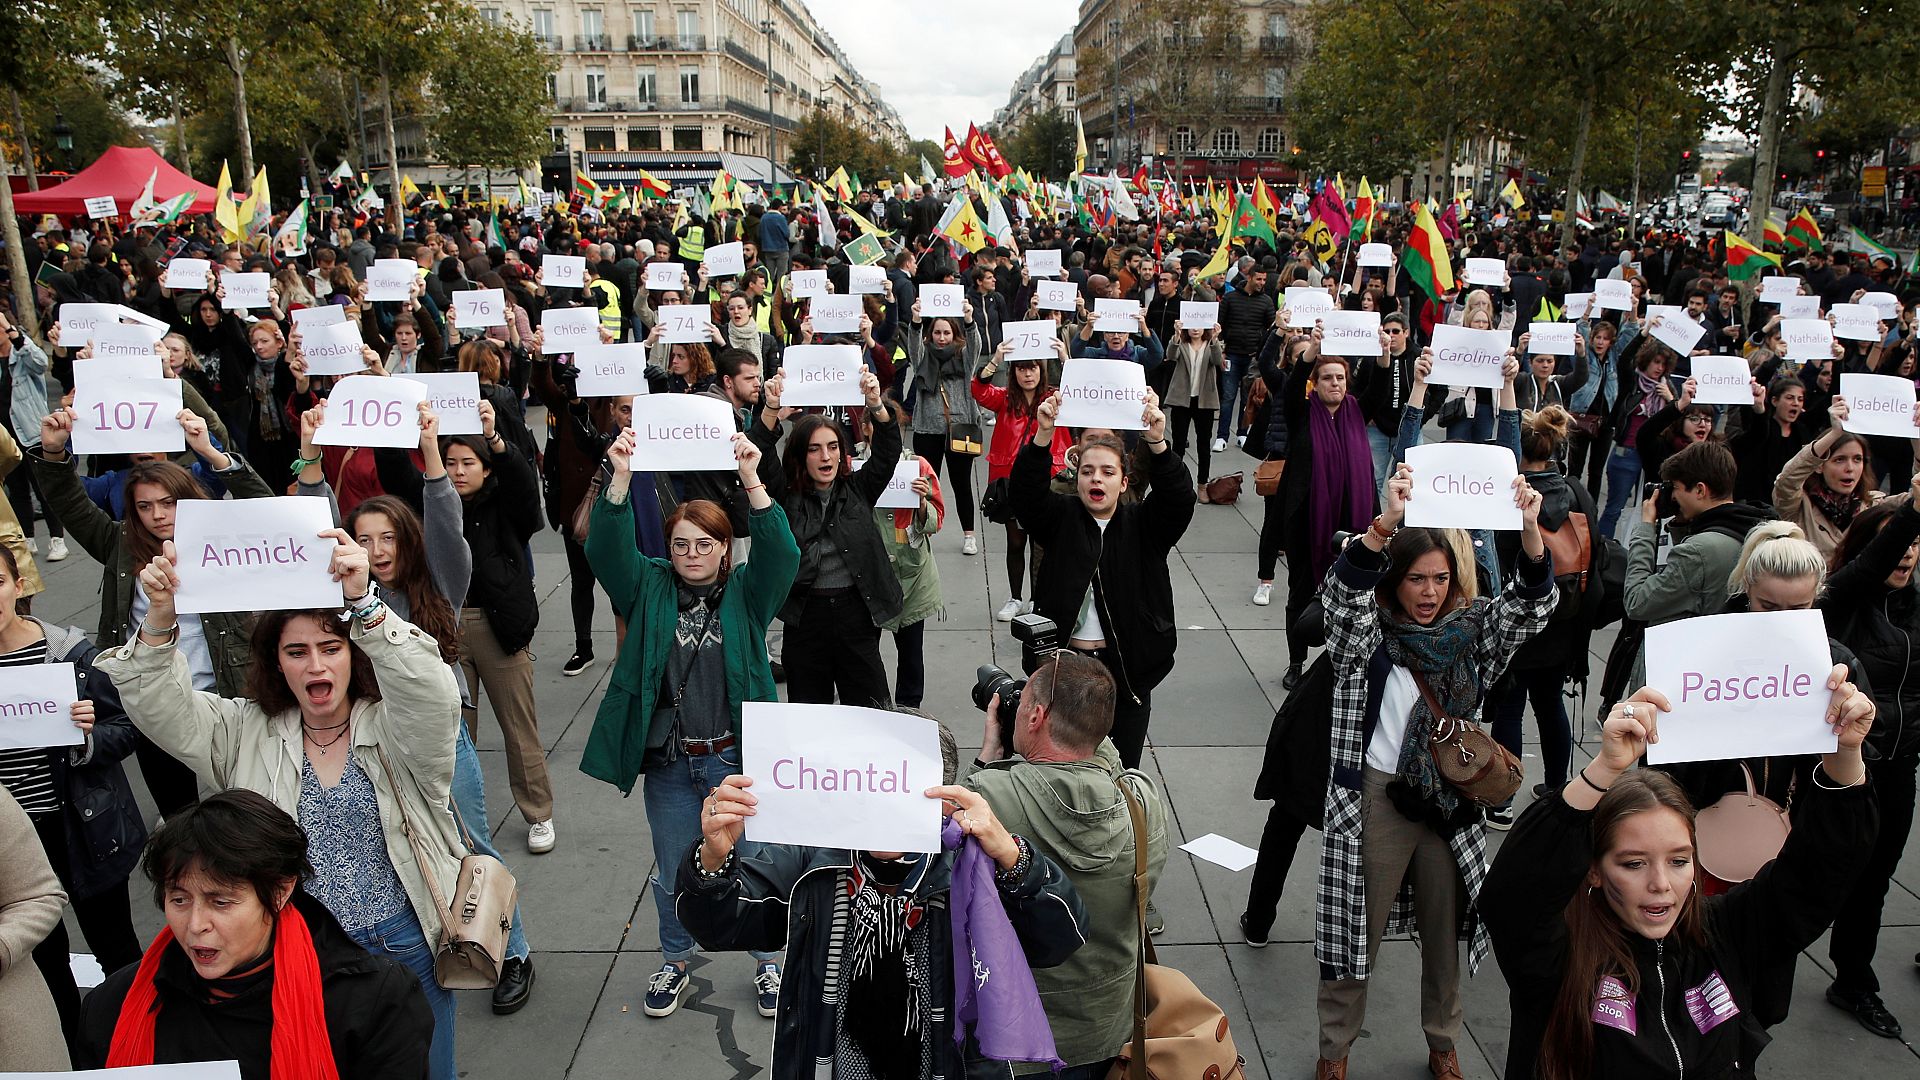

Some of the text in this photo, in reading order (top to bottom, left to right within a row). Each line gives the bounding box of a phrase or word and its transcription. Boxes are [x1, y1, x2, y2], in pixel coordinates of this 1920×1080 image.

[1195, 149, 1257, 159] PIZZA PINO
[556, 266, 572, 278] 19
[657, 271, 673, 282] 67
[374, 279, 401, 288] Céline
[803, 279, 817, 289] 10
[933, 294, 951, 307] 68
[1049, 290, 1064, 302] 63
[468, 301, 490, 316] 76
[817, 308, 854, 318] Mélissa
[553, 323, 587, 336] Chloé
[674, 317, 695, 332] 74
[1019, 332, 1041, 348] 75
[1333, 327, 1372, 339] Sandra
[1537, 332, 1568, 342] Ginette
[1789, 333, 1829, 344] Nathalie
[101, 342, 149, 356] Femme
[1439, 348, 1501, 365] Caroline
[595, 362, 625, 376] Leïla
[800, 368, 845, 383] Jackie
[1702, 373, 1745, 386] Chantal
[1062, 384, 1144, 401] Antoinette
[430, 396, 475, 409] ricette
[1852, 396, 1908, 414] Isabelle
[92, 401, 159, 431] 107
[341, 399, 402, 427] 106
[647, 423, 721, 440] Lucette
[888, 478, 906, 490] ela
[1432, 473, 1495, 496] Chloé
[201, 537, 308, 567] Annick
[1682, 664, 1811, 703] Pascale
[0, 700, 58, 717] mme
[772, 756, 911, 794] Chantal
[1597, 1002, 1625, 1019] Stop.
